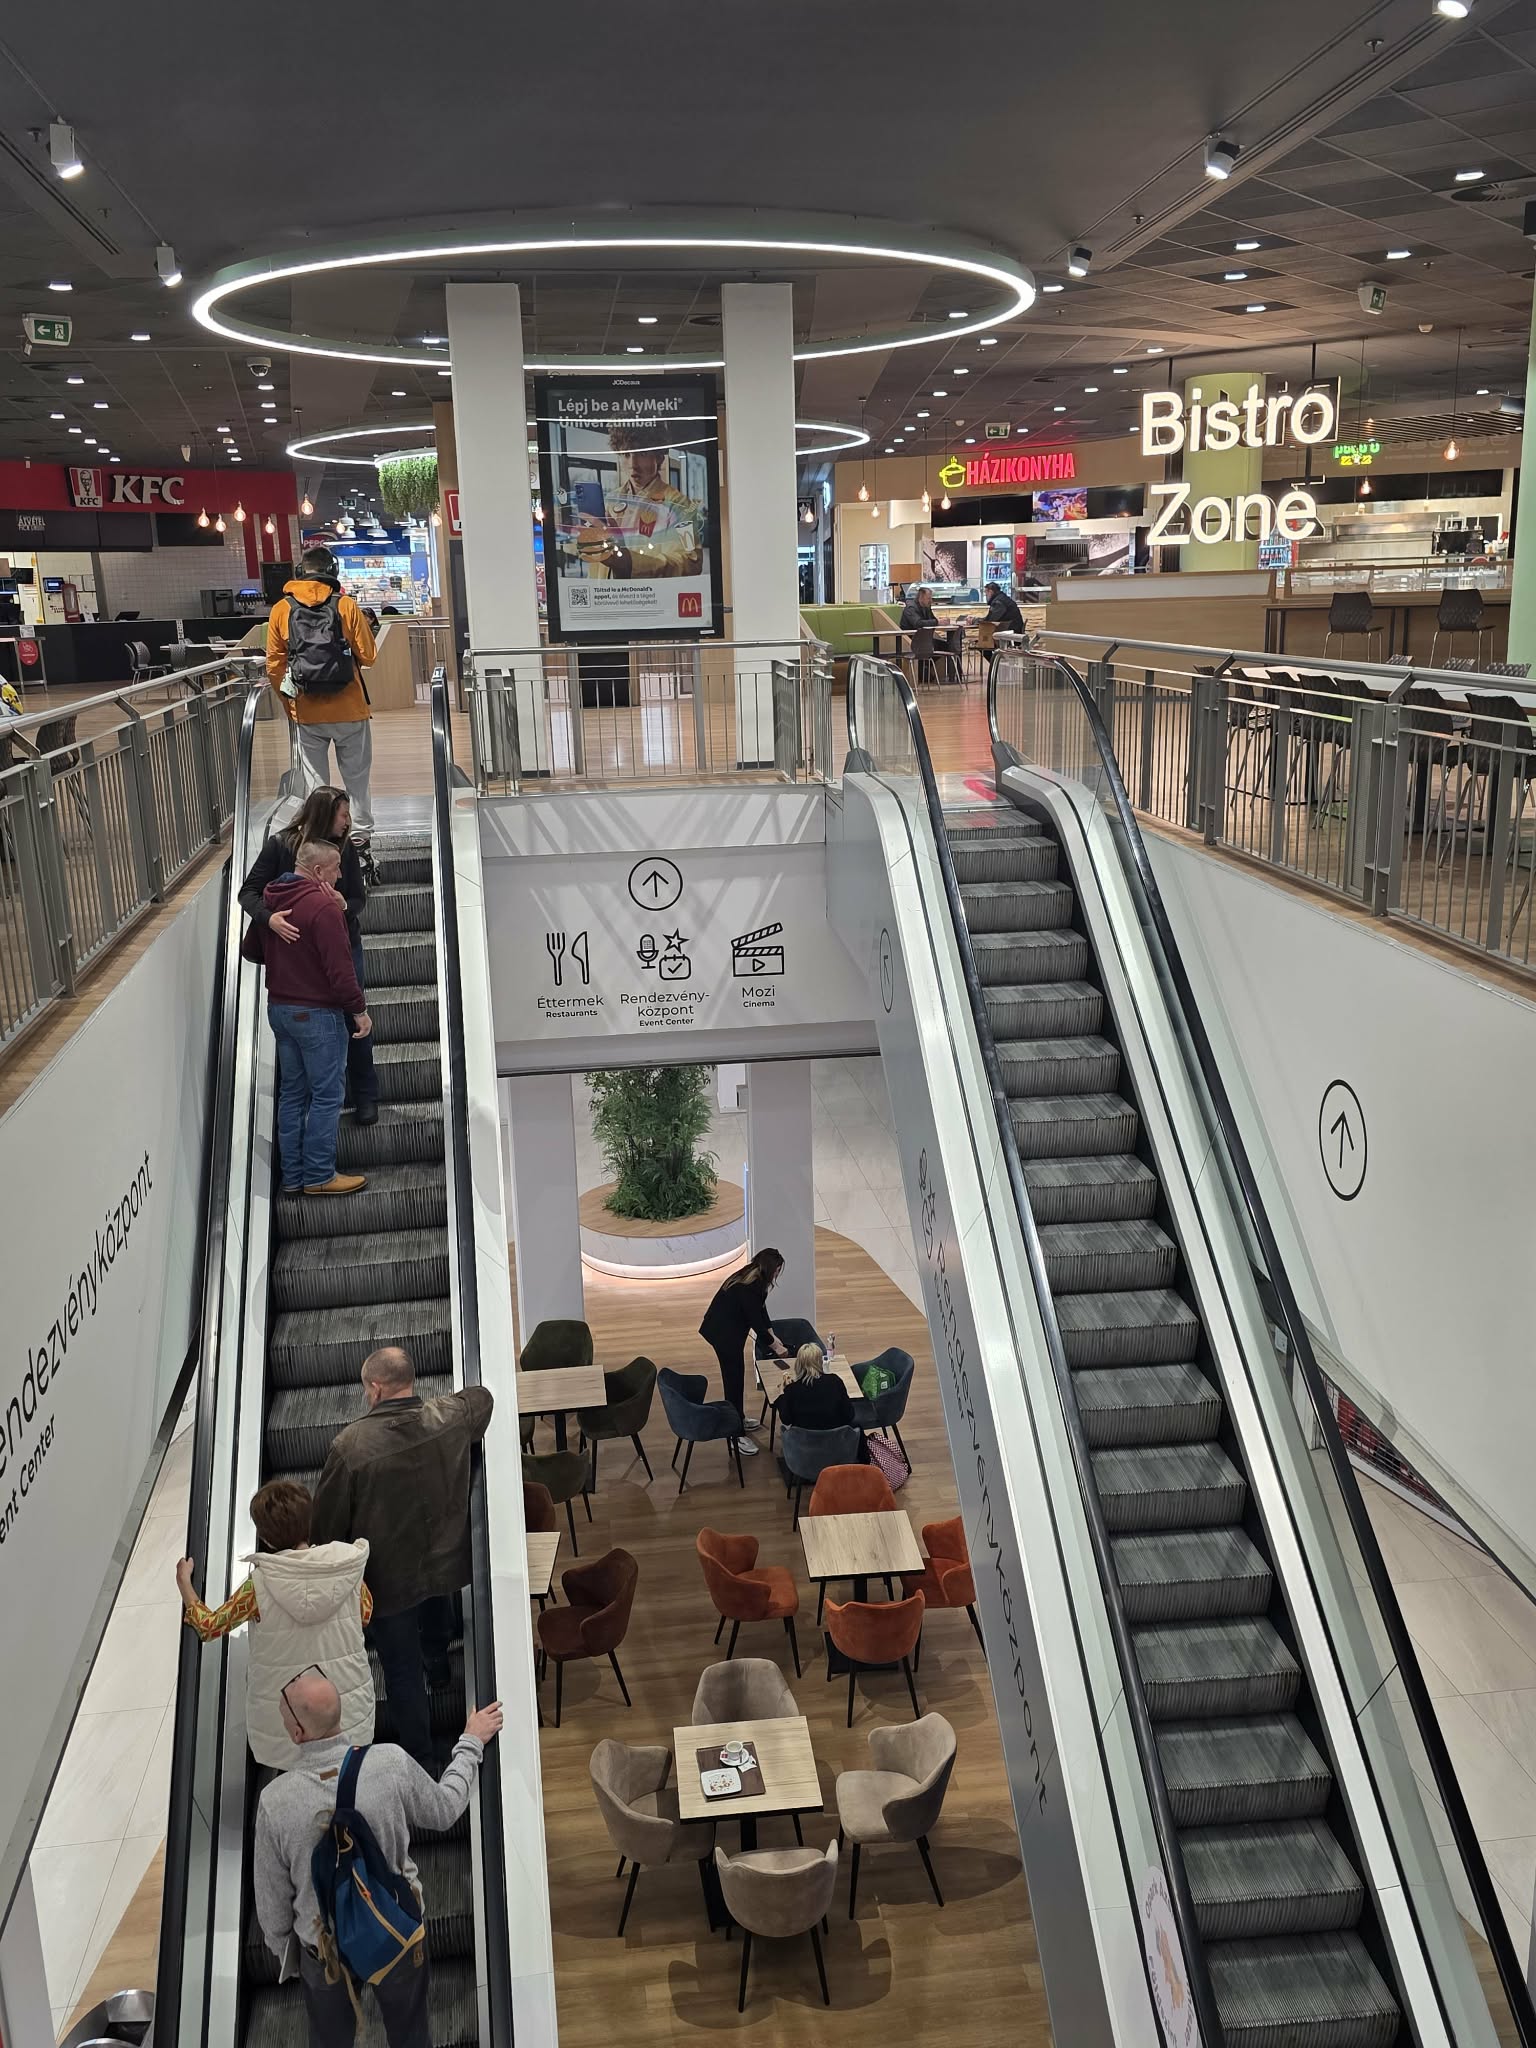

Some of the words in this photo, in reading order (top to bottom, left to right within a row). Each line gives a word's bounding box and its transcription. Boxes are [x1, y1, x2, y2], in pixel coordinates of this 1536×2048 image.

[558, 398, 588, 415] Lépj
[591, 398, 609, 412] be
[611, 401, 620, 412] a
[1142, 383, 1335, 456] Bistro
[966, 452, 1076, 486] HÁZIKONYHA
[112, 474, 185, 506] KFC
[79, 497, 100, 506] KFC
[1146, 482, 1318, 546] Zone
[620, 991, 711, 1005] Rendezvény-
[741, 984, 776, 999] Mozi
[537, 995, 605, 1009] Éttermek
[743, 1000, 775, 1008] Cinema
[545, 1008, 598, 1018] Restaurants
[637, 1004, 695, 1018] központ
[639, 1018, 664, 1027] Event
[665, 1017, 694, 1026] Center
[0, 1150, 153, 1479] endezvényközpont
[933, 1270, 949, 1340] Event
[947, 1340, 965, 1420] Center
[0, 1487, 19, 1544] ent
[20, 1413, 55, 1498] Center
[937, 1239, 1049, 1817] Rendezvényközpont
